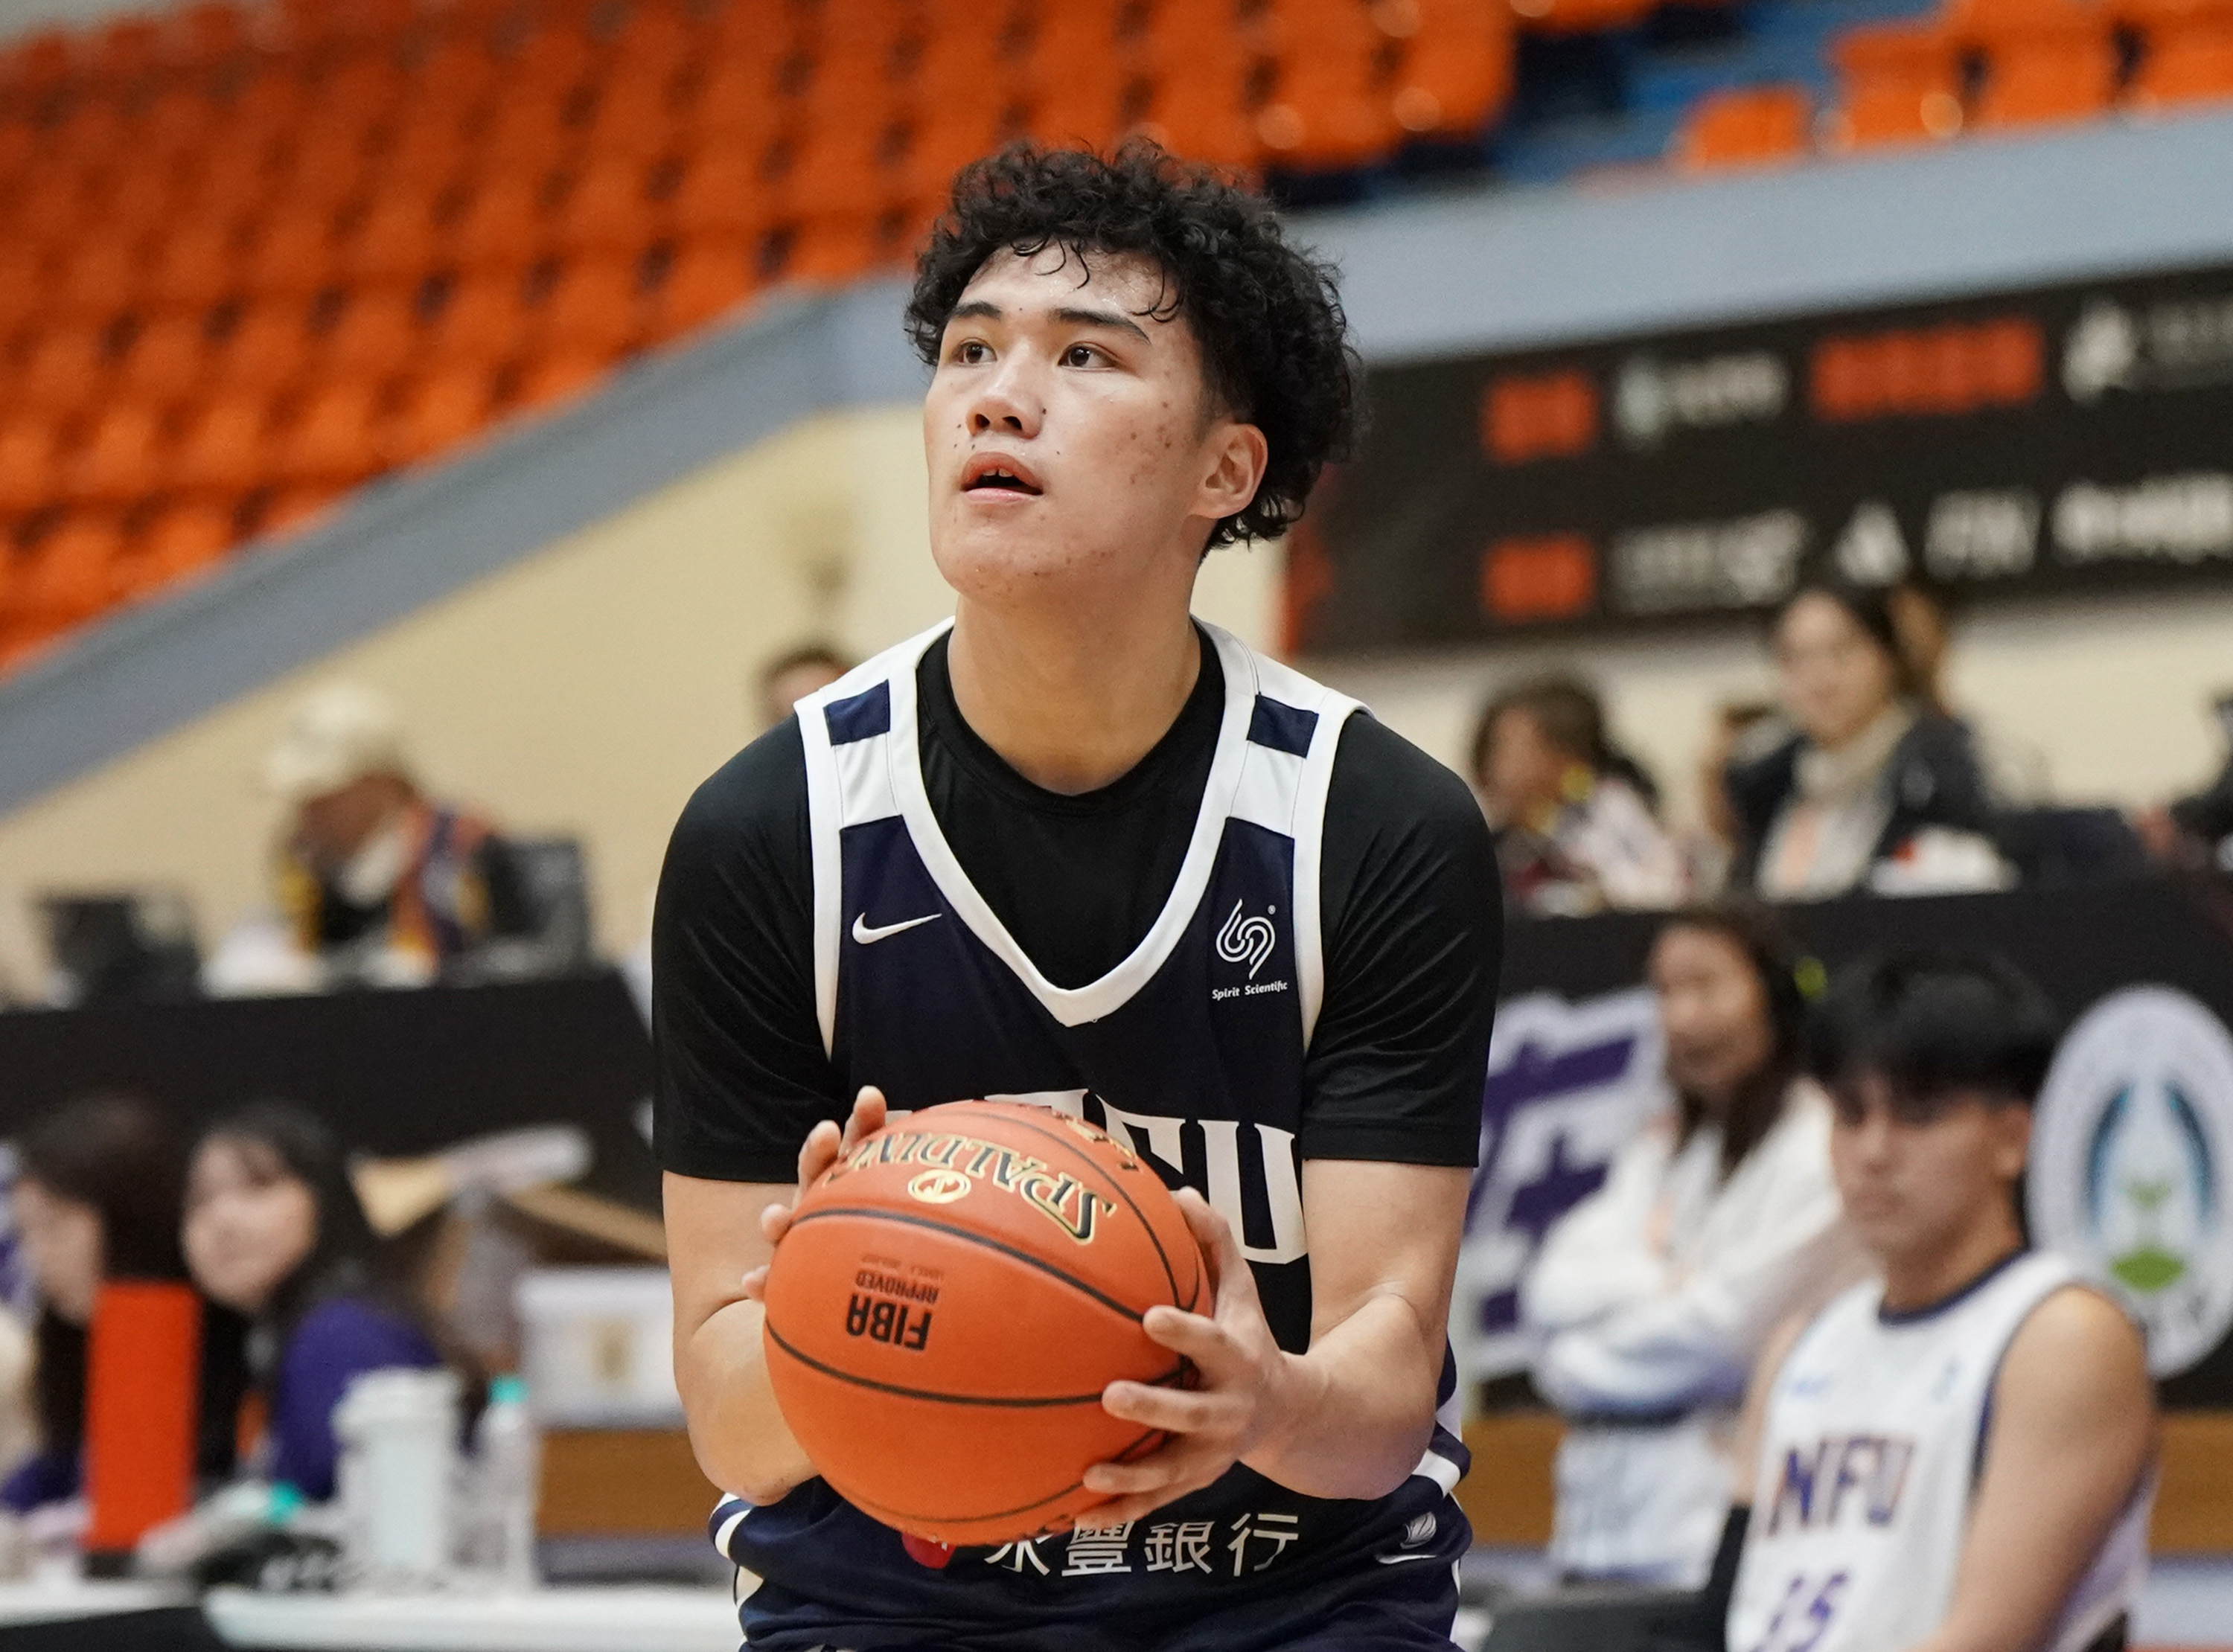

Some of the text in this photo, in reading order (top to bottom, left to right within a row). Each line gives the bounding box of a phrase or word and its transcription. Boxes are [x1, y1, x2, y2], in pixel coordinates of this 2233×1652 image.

[1212, 980, 1288, 1001] Spirit Scientific
[846, 1293, 932, 1351] FIBA
